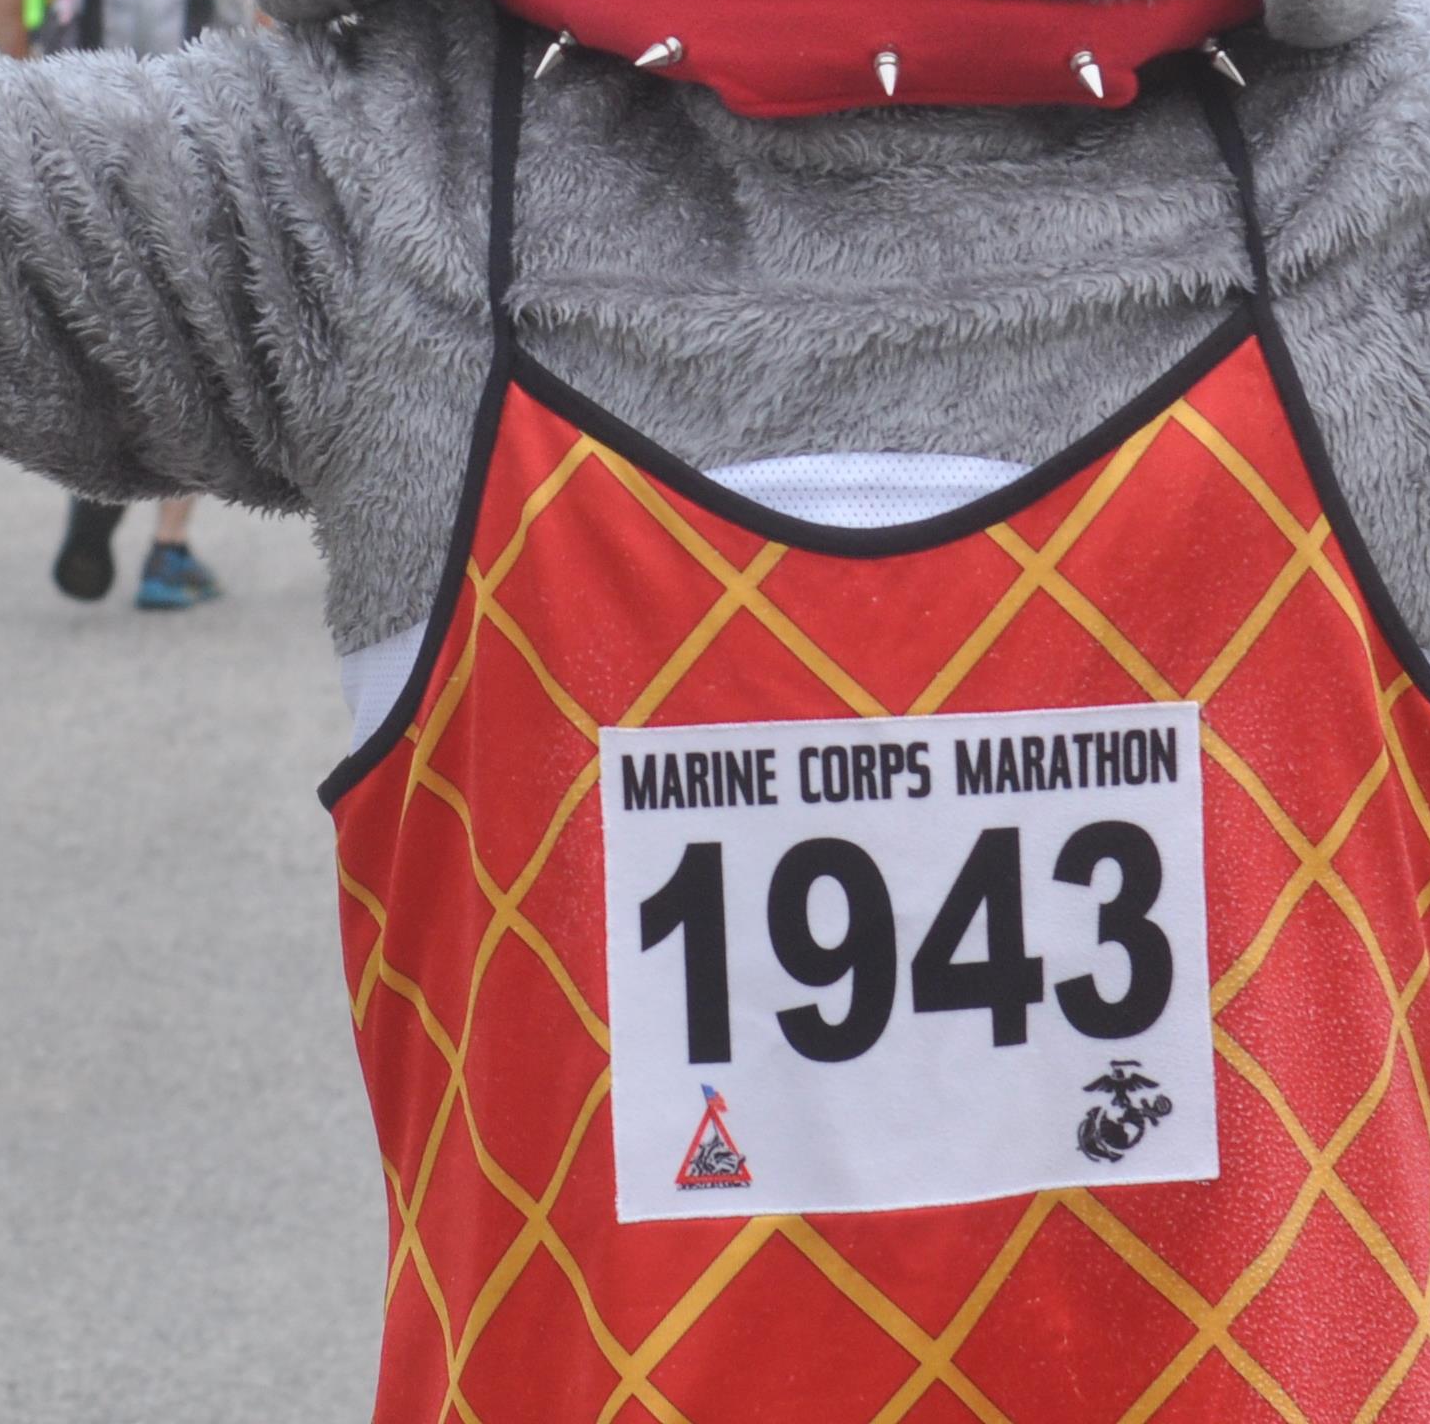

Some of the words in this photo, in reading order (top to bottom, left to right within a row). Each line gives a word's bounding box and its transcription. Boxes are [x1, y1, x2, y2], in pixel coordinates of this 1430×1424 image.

[622, 749, 778, 811] MARINE
[799, 741, 931, 804] CORPS
[955, 727, 1177, 796] MARATHON
[639, 820, 1174, 1071] 1943
